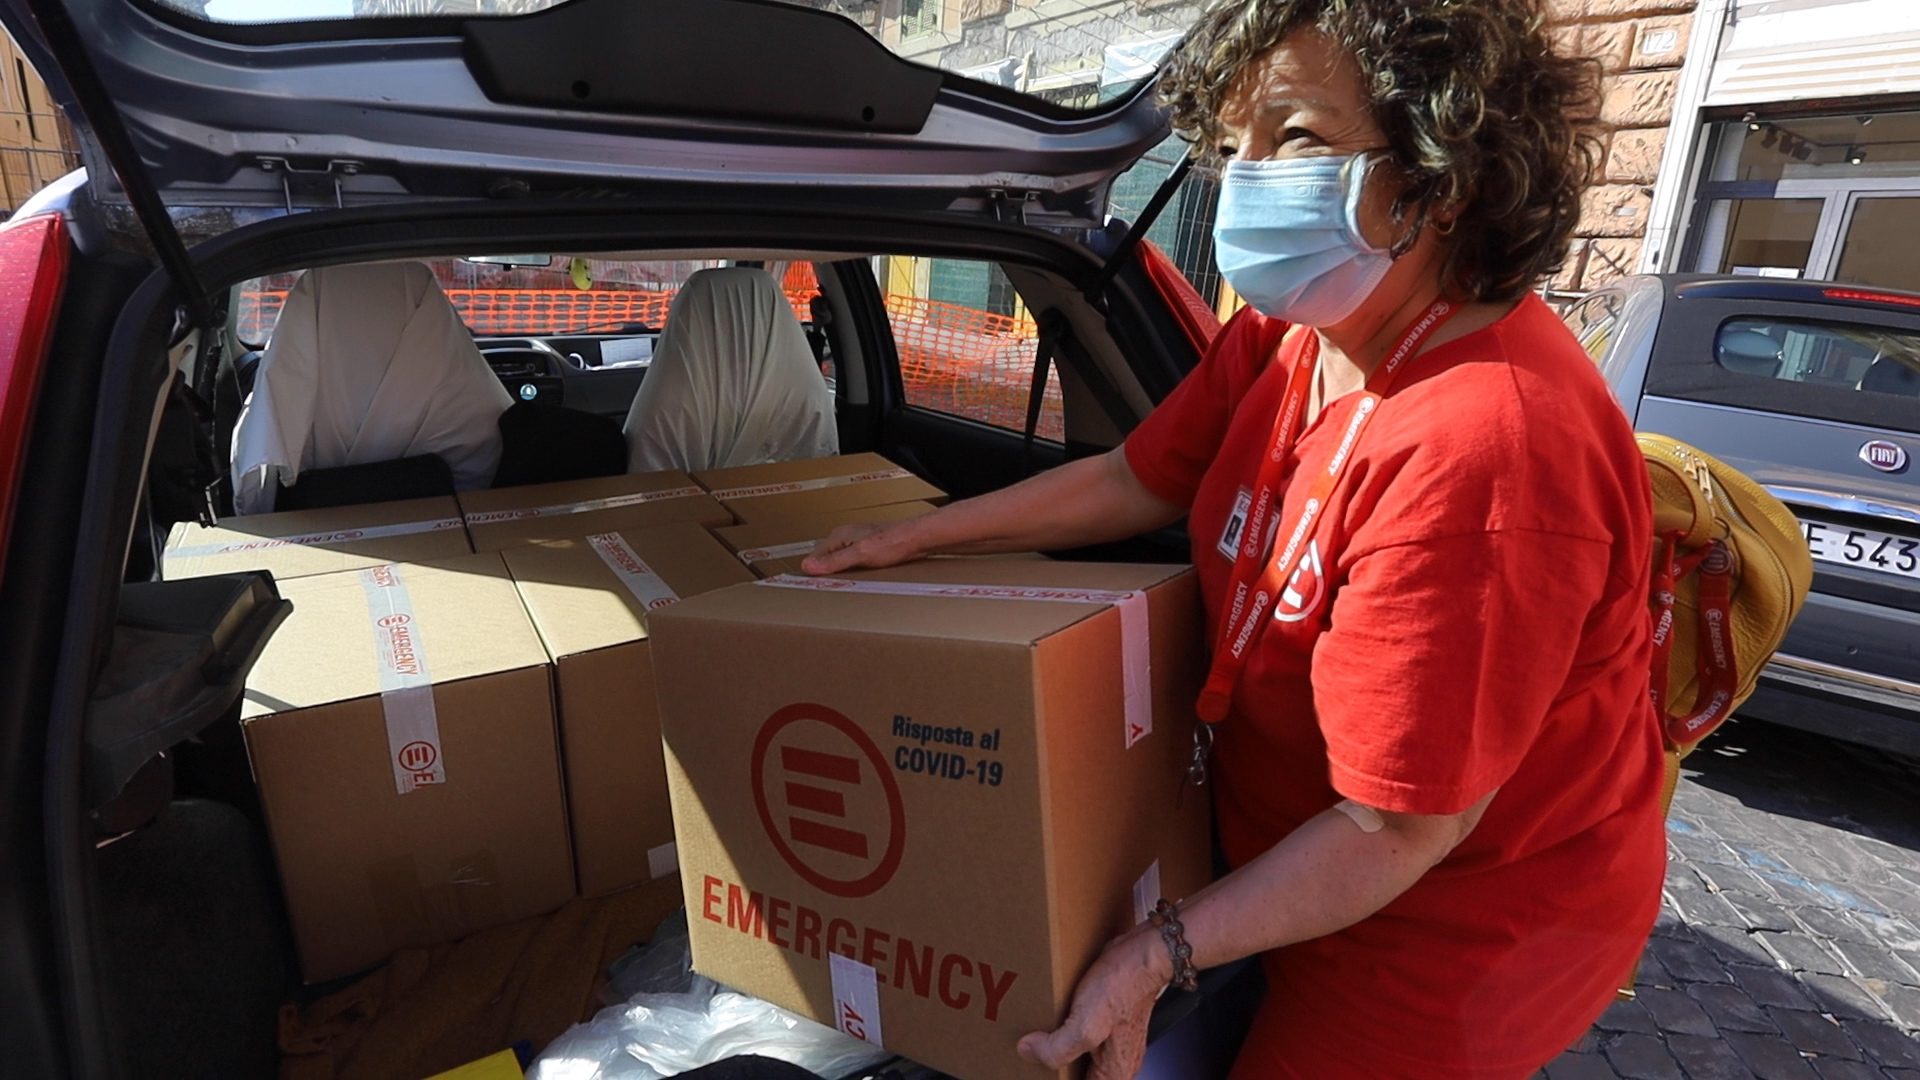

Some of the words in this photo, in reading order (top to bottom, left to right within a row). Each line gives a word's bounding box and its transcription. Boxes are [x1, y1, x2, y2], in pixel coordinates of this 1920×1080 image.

[1386, 313, 1436, 373] EMERGENCY
[1276, 391, 1298, 448] EMERGENCY
[1871, 446, 1896, 464] FIAT
[1249, 485, 1271, 545] EMERGENCY
[1278, 511, 1312, 571] EMERGENCY
[1843, 530, 1919, 573] 543
[390, 626, 418, 675] EMERGENCY
[1231, 602, 1263, 659] EMERGENCY
[1709, 621, 1727, 669] EMERGENCY
[892, 714, 974, 746] Risposta
[980, 728, 1001, 751] al
[1685, 700, 1723, 732] EMERGENCY
[895, 745, 1004, 787] COVID-19
[702, 874, 1017, 1022] EMERGENCY
